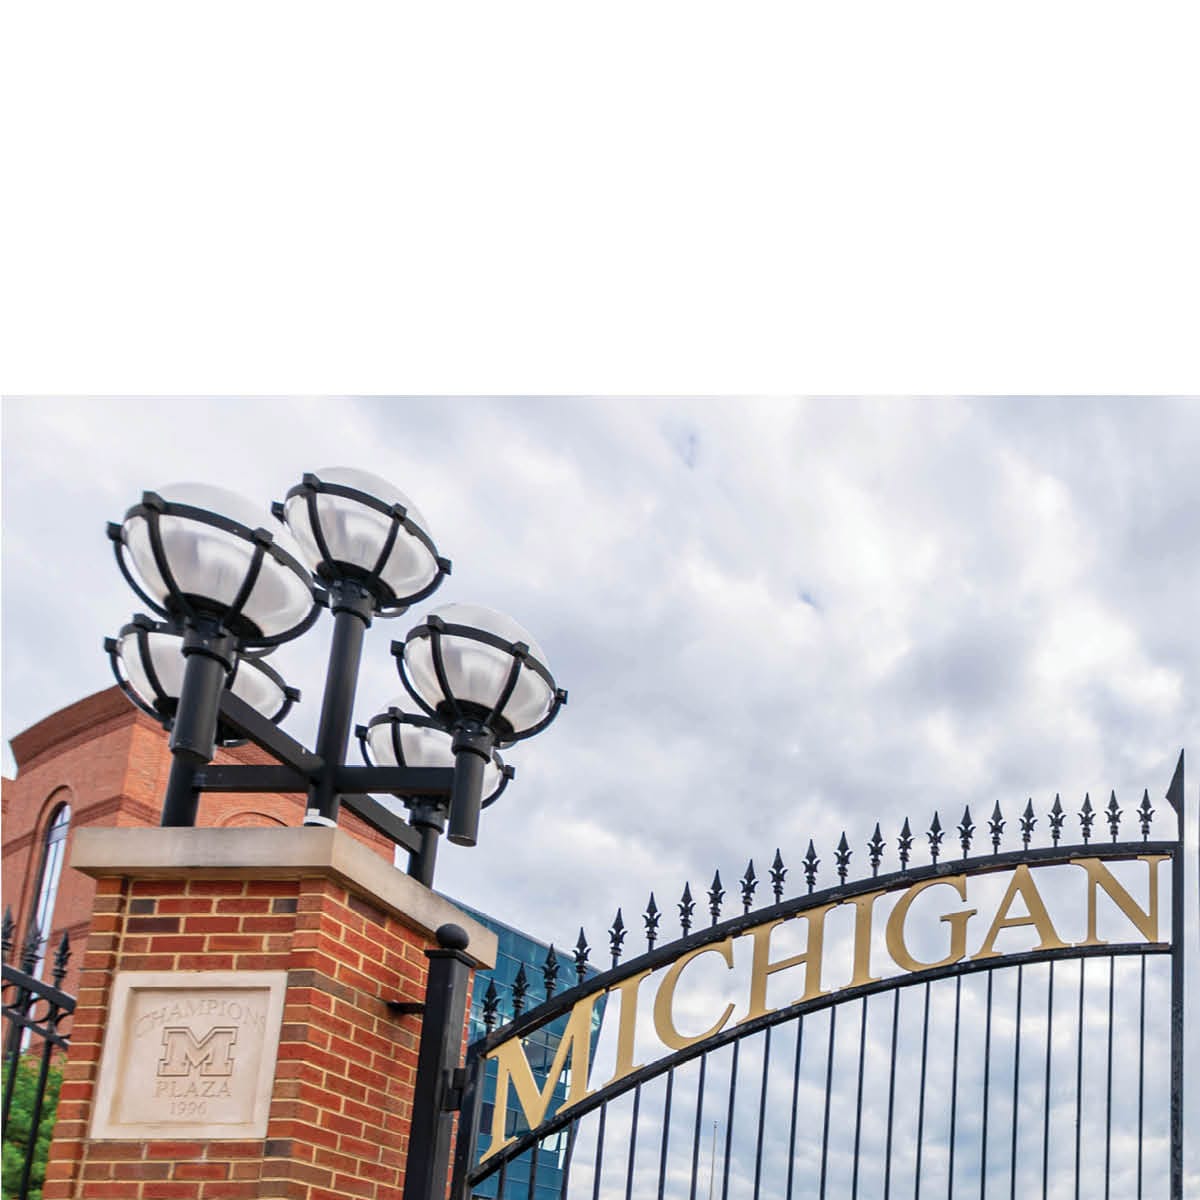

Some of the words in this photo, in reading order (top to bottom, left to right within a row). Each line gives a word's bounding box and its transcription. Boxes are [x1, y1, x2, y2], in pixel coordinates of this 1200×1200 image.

[479, 854, 1170, 1164] MICHIGAN
[157, 1026, 239, 1077] M
[155, 1080, 232, 1098] PLAZA
[170, 1101, 208, 1116] 1996
